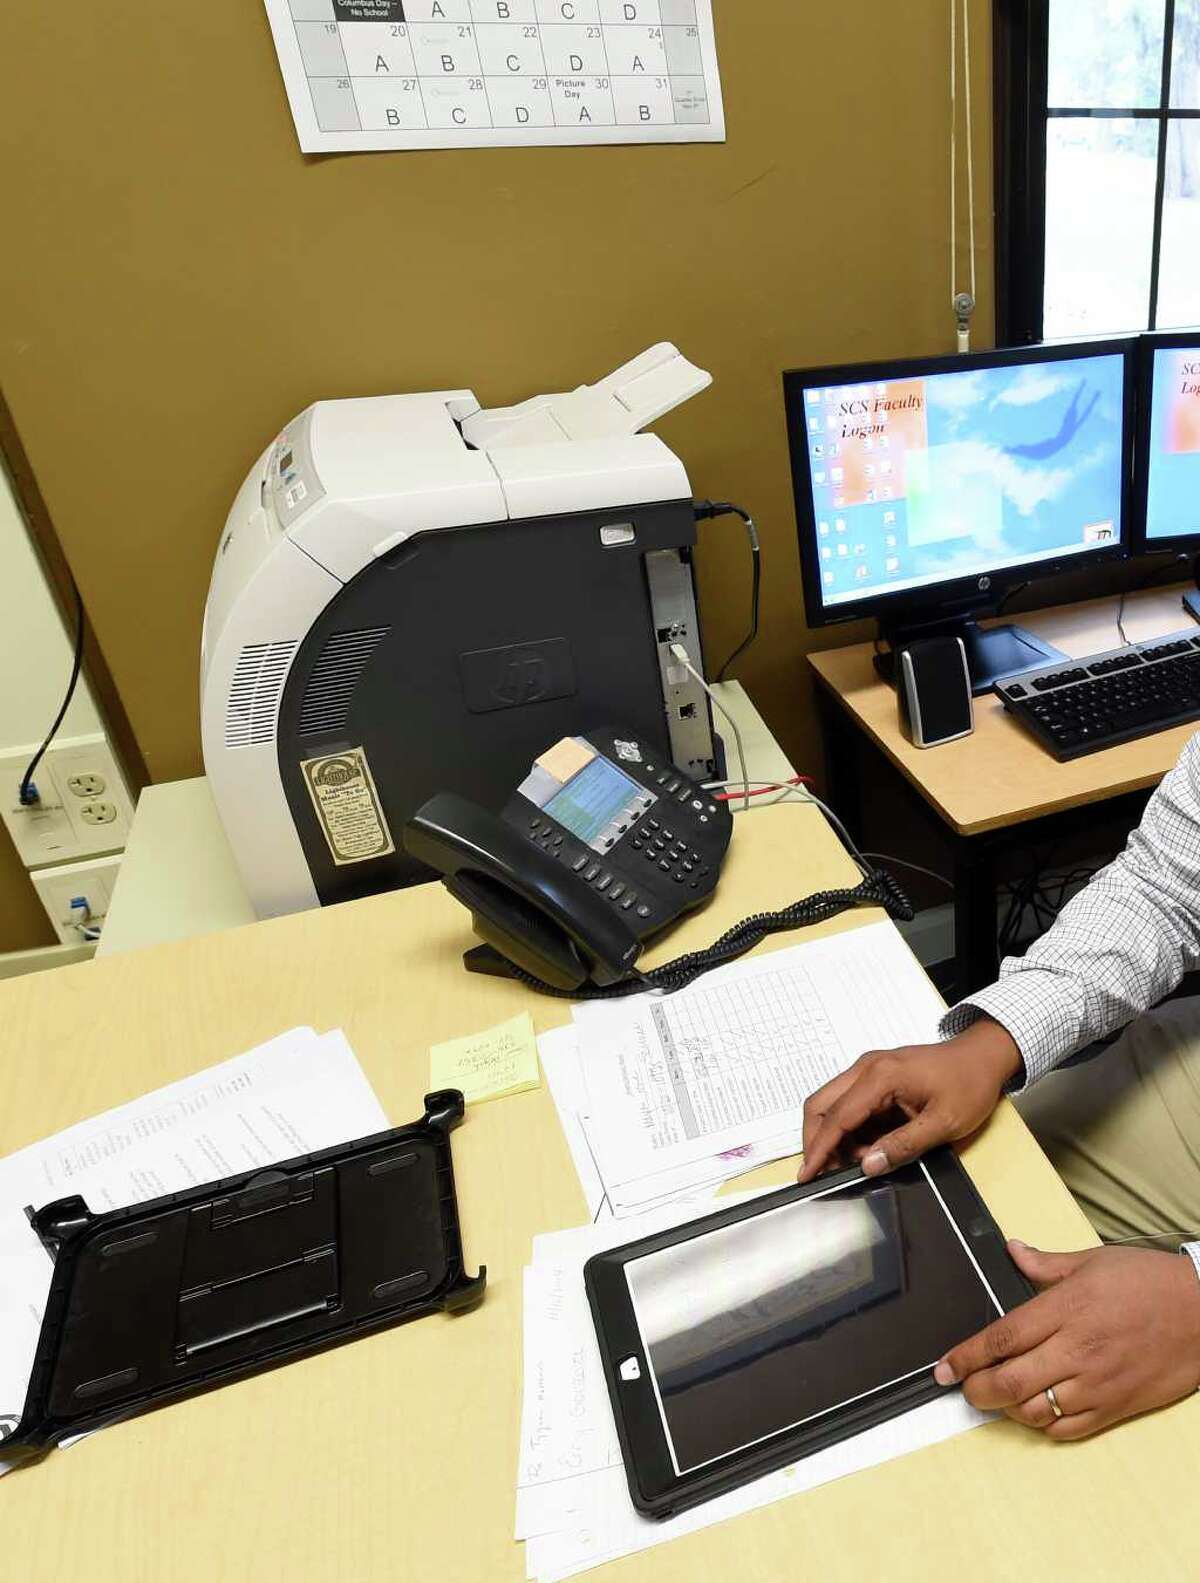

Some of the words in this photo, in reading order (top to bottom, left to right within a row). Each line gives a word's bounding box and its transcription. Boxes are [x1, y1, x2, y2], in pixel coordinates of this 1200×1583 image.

[363, 8, 389, 16] School
[431, 1, 446, 18] A
[496, 2, 510, 19] B
[560, 3, 575, 20] C
[623, 4, 637, 21] D
[324, 25, 337, 34] 19
[390, 25, 406, 37] 20
[457, 26, 472, 38] 21
[522, 27, 537, 38] 22
[587, 27, 601, 38] 23
[648, 28, 661, 39] 24
[375, 55, 389, 73] A
[441, 54, 455, 72] B
[506, 55, 520, 72] C
[569, 55, 583, 71] D
[632, 55, 645, 72] A
[336, 79, 350, 89] 26
[402, 80, 416, 91] 27
[468, 79, 483, 90] 28
[532, 78, 547, 90] 29
[555, 79, 586, 88] Picture
[594, 78, 609, 90] 30
[655, 78, 668, 89] 31
[564, 90, 581, 100] Day
[386, 109, 400, 126] B
[451, 107, 467, 124] C
[515, 107, 529, 123] D
[579, 106, 592, 122] A
[639, 105, 652, 121] B
[838, 398, 869, 417] SCS
[873, 393, 923, 414] Faculty
[841, 422, 885, 440] Logon
